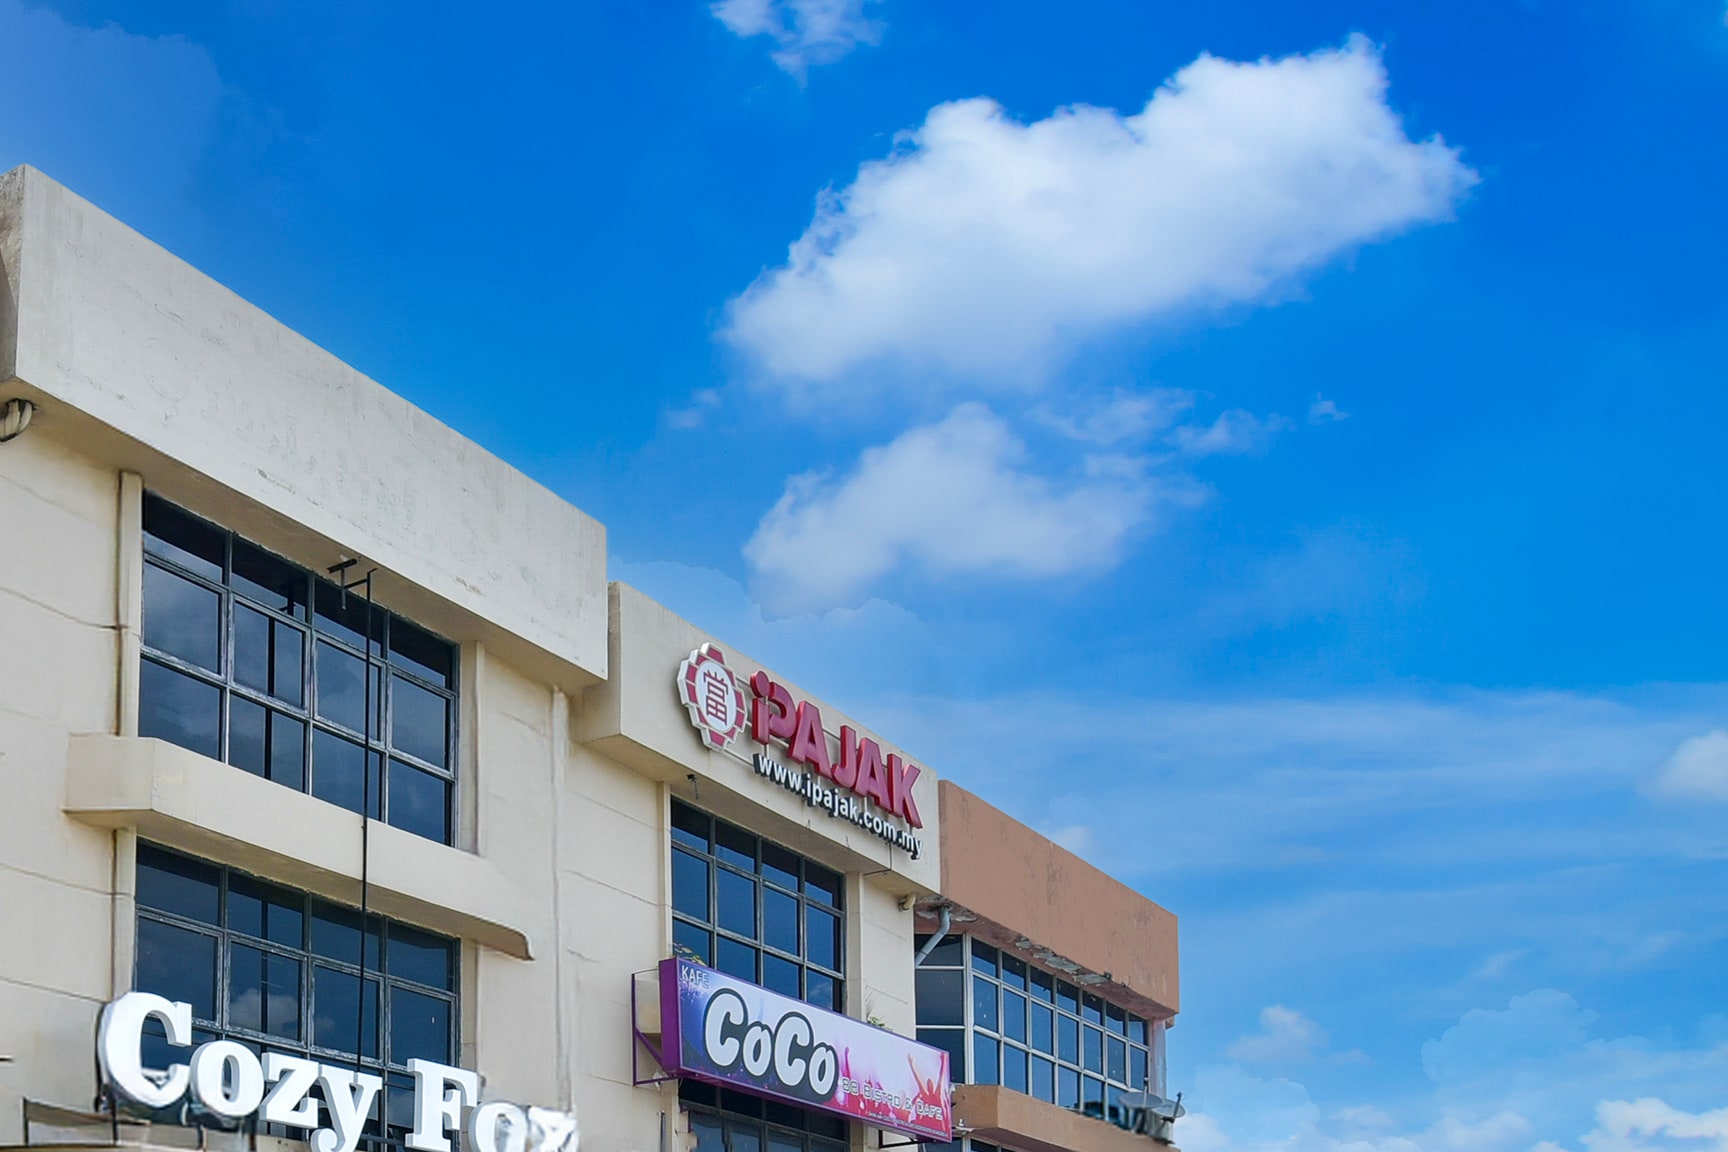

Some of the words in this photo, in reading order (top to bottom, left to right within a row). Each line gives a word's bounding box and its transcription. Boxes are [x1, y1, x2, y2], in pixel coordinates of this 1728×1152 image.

[750, 670, 923, 829] iPAJAK
[755, 753, 922, 859] www.ipajak.com.my
[681, 965, 710, 988] KAFE
